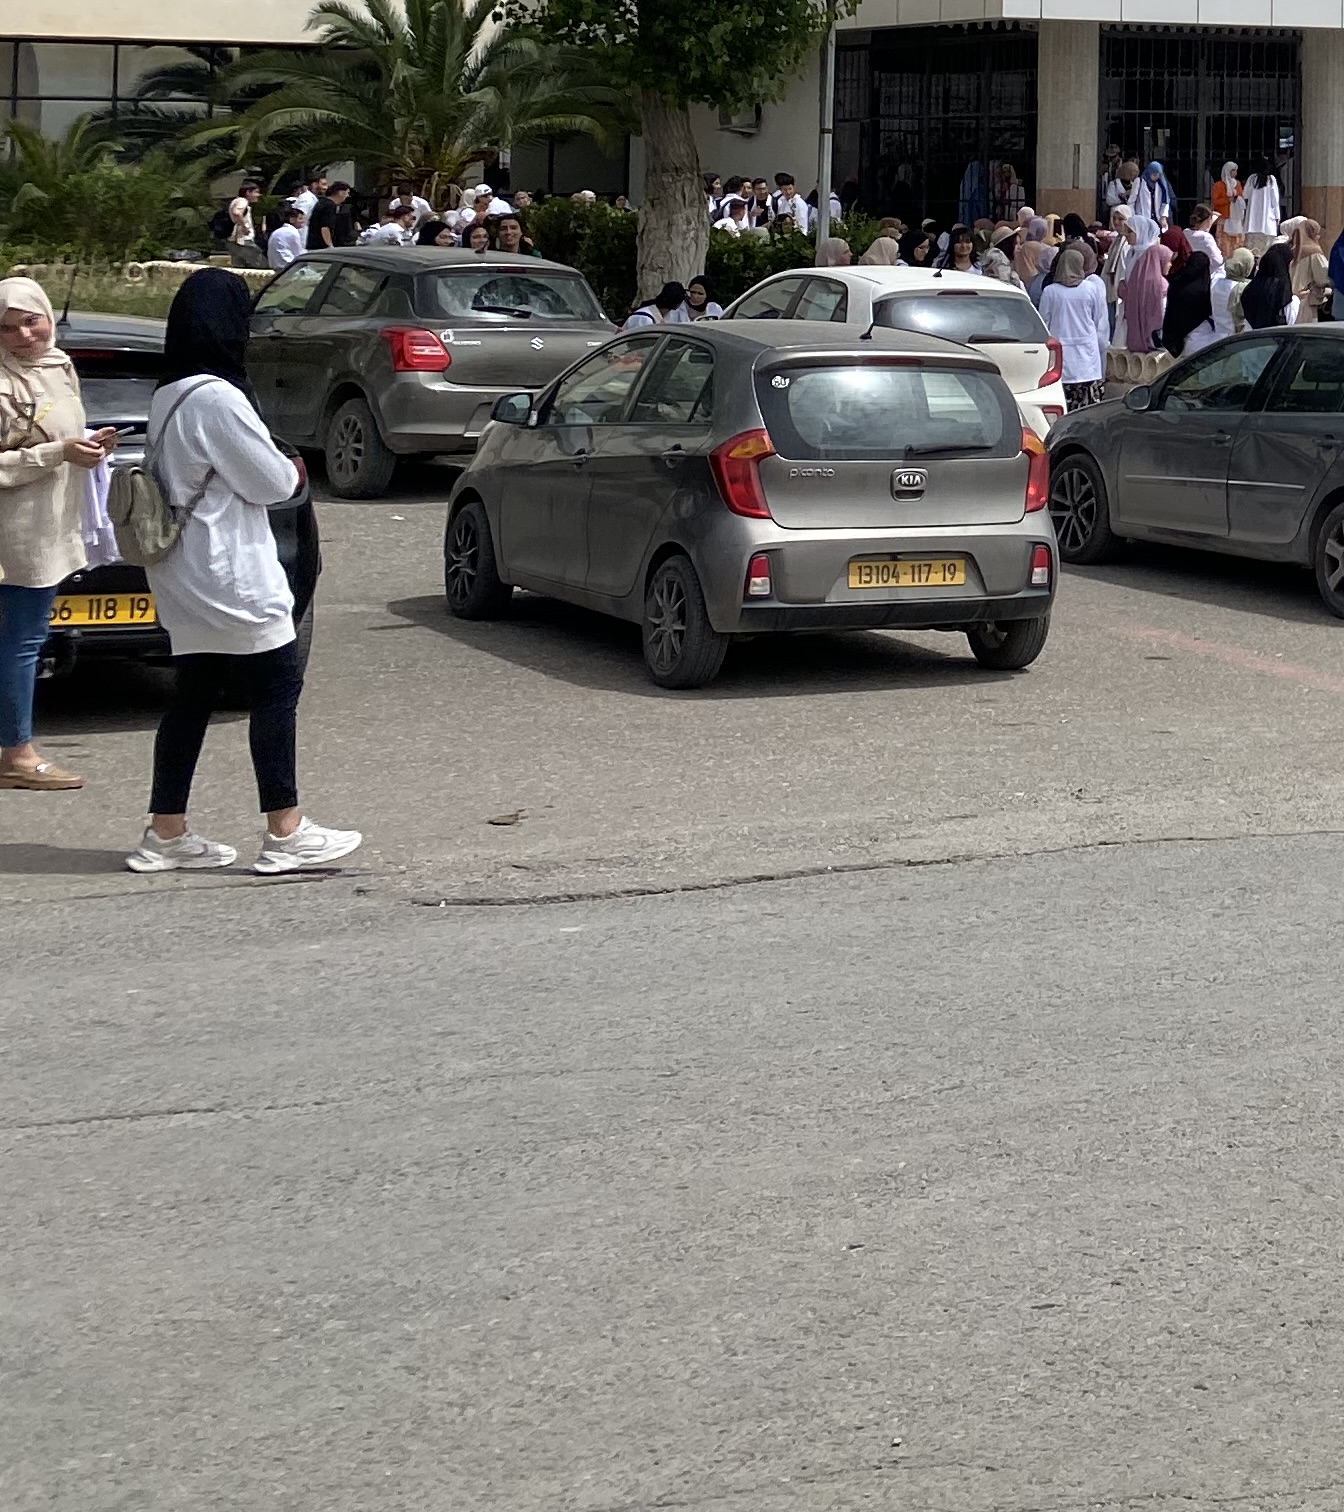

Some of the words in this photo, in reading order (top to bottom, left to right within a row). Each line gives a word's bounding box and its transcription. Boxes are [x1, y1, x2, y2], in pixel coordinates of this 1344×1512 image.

[900, 474, 921, 486] KIA
[87, 597, 118, 620] 118
[129, 597, 150, 620] 19
